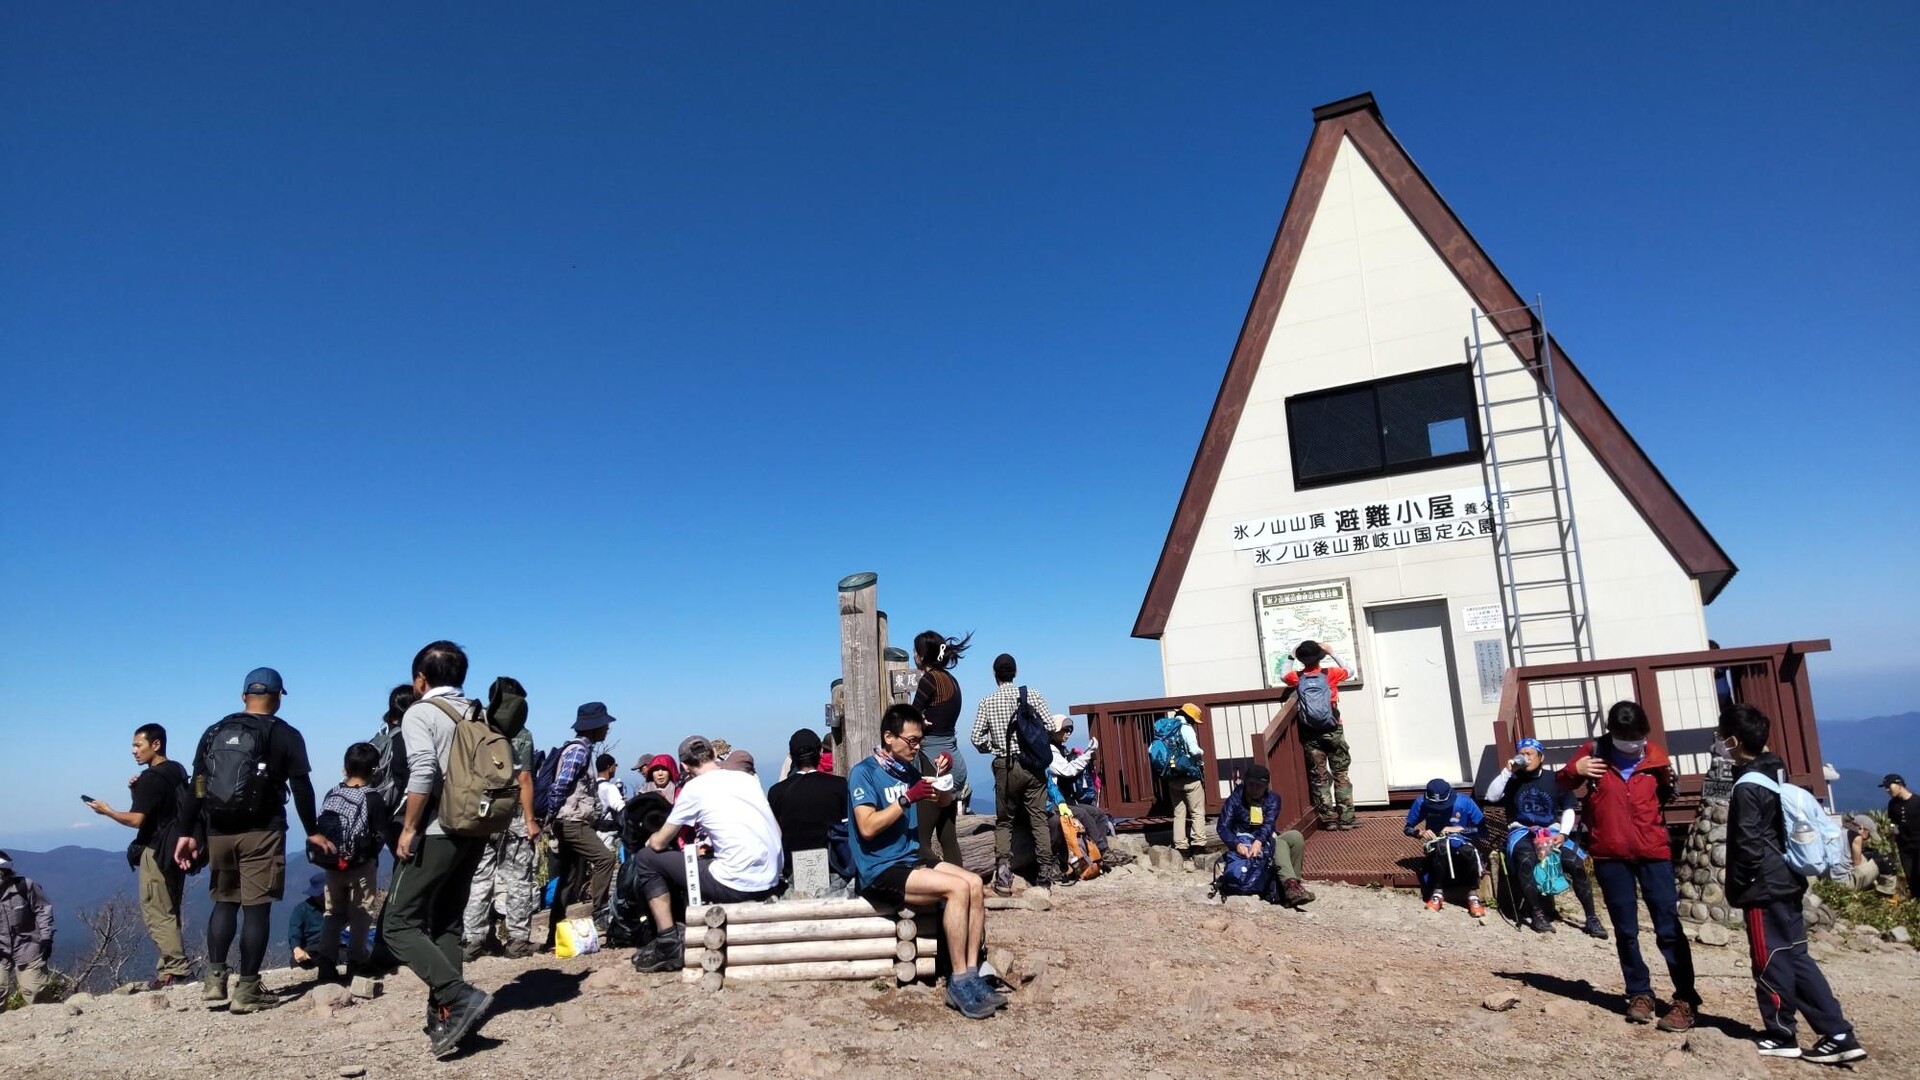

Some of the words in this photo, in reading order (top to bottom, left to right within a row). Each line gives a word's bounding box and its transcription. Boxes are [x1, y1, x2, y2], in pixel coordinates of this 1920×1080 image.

[1233, 514, 1326, 540] 氷ノ山山頂
[1334, 495, 1455, 533] 避難小屋
[1255, 517, 1496, 564] 氷ノ山後山那岐山国定公園
[895, 671, 925, 687] 東尾
